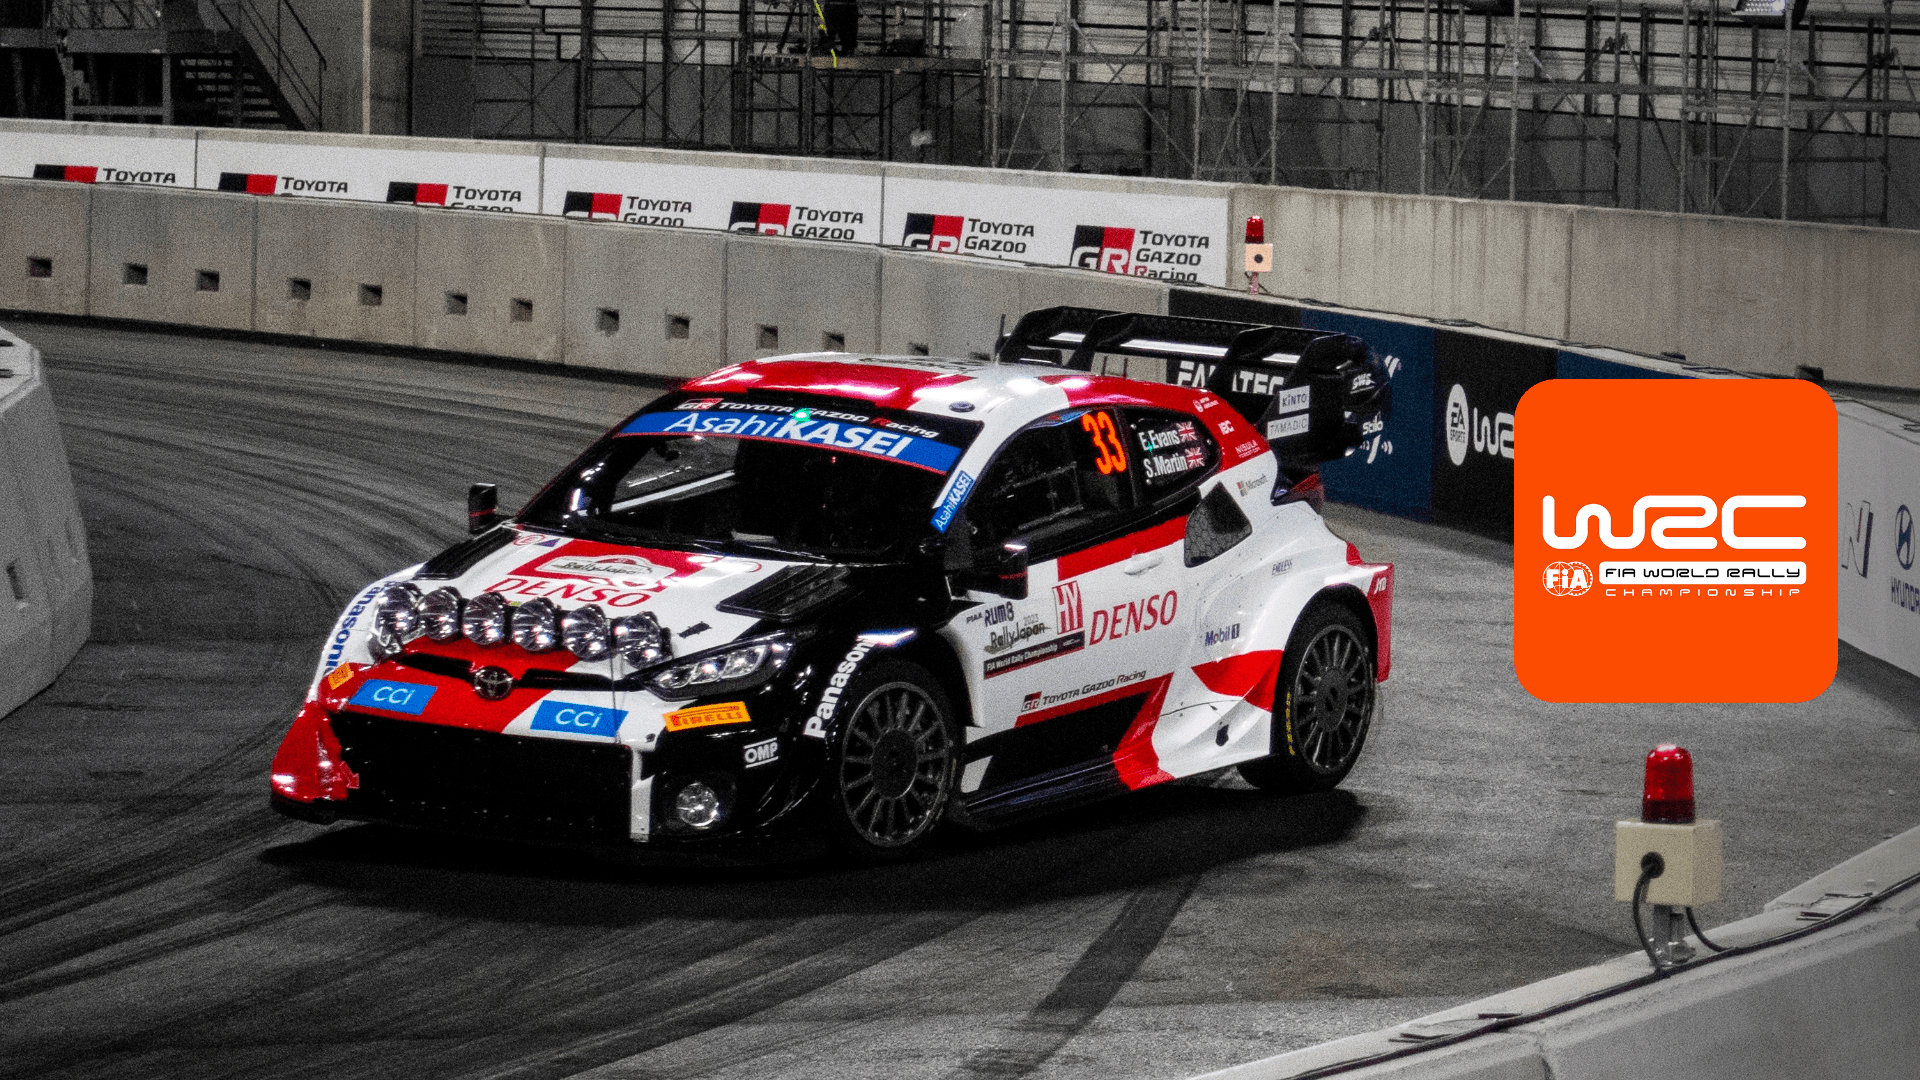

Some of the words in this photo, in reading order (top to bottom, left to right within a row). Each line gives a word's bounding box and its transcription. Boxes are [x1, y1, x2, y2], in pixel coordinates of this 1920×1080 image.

[103, 168, 176, 184] TOYOTA
[281, 176, 348, 193] TOYOTA
[453, 186, 522, 202] TOYOTA
[626, 196, 692, 213] TOYOTA
[795, 206, 863, 224] TOYOTA
[791, 223, 855, 240] GAZOO
[968, 218, 1035, 237] TOYOTA
[965, 235, 1027, 254] GAZOO
[1139, 230, 1210, 249] TOYOTA
[1071, 246, 1130, 275] GR
[1136, 248, 1202, 266] GAZOO
[719, 402, 794, 413] TOYOTA
[871, 418, 939, 439] Racing
[1451, 402, 1466, 430] EA
[1081, 411, 1127, 475] 33
[483, 578, 651, 608] DENSO
[1089, 590, 1178, 646] DENSO
[1205, 627, 1230, 647] Mobil
[803, 637, 876, 739] Panasoni
[1042, 688, 1079, 705] TOYOTA
[1082, 679, 1114, 695] GAZOO
[1116, 670, 1146, 685] Racing
[744, 741, 778, 764] OMP
